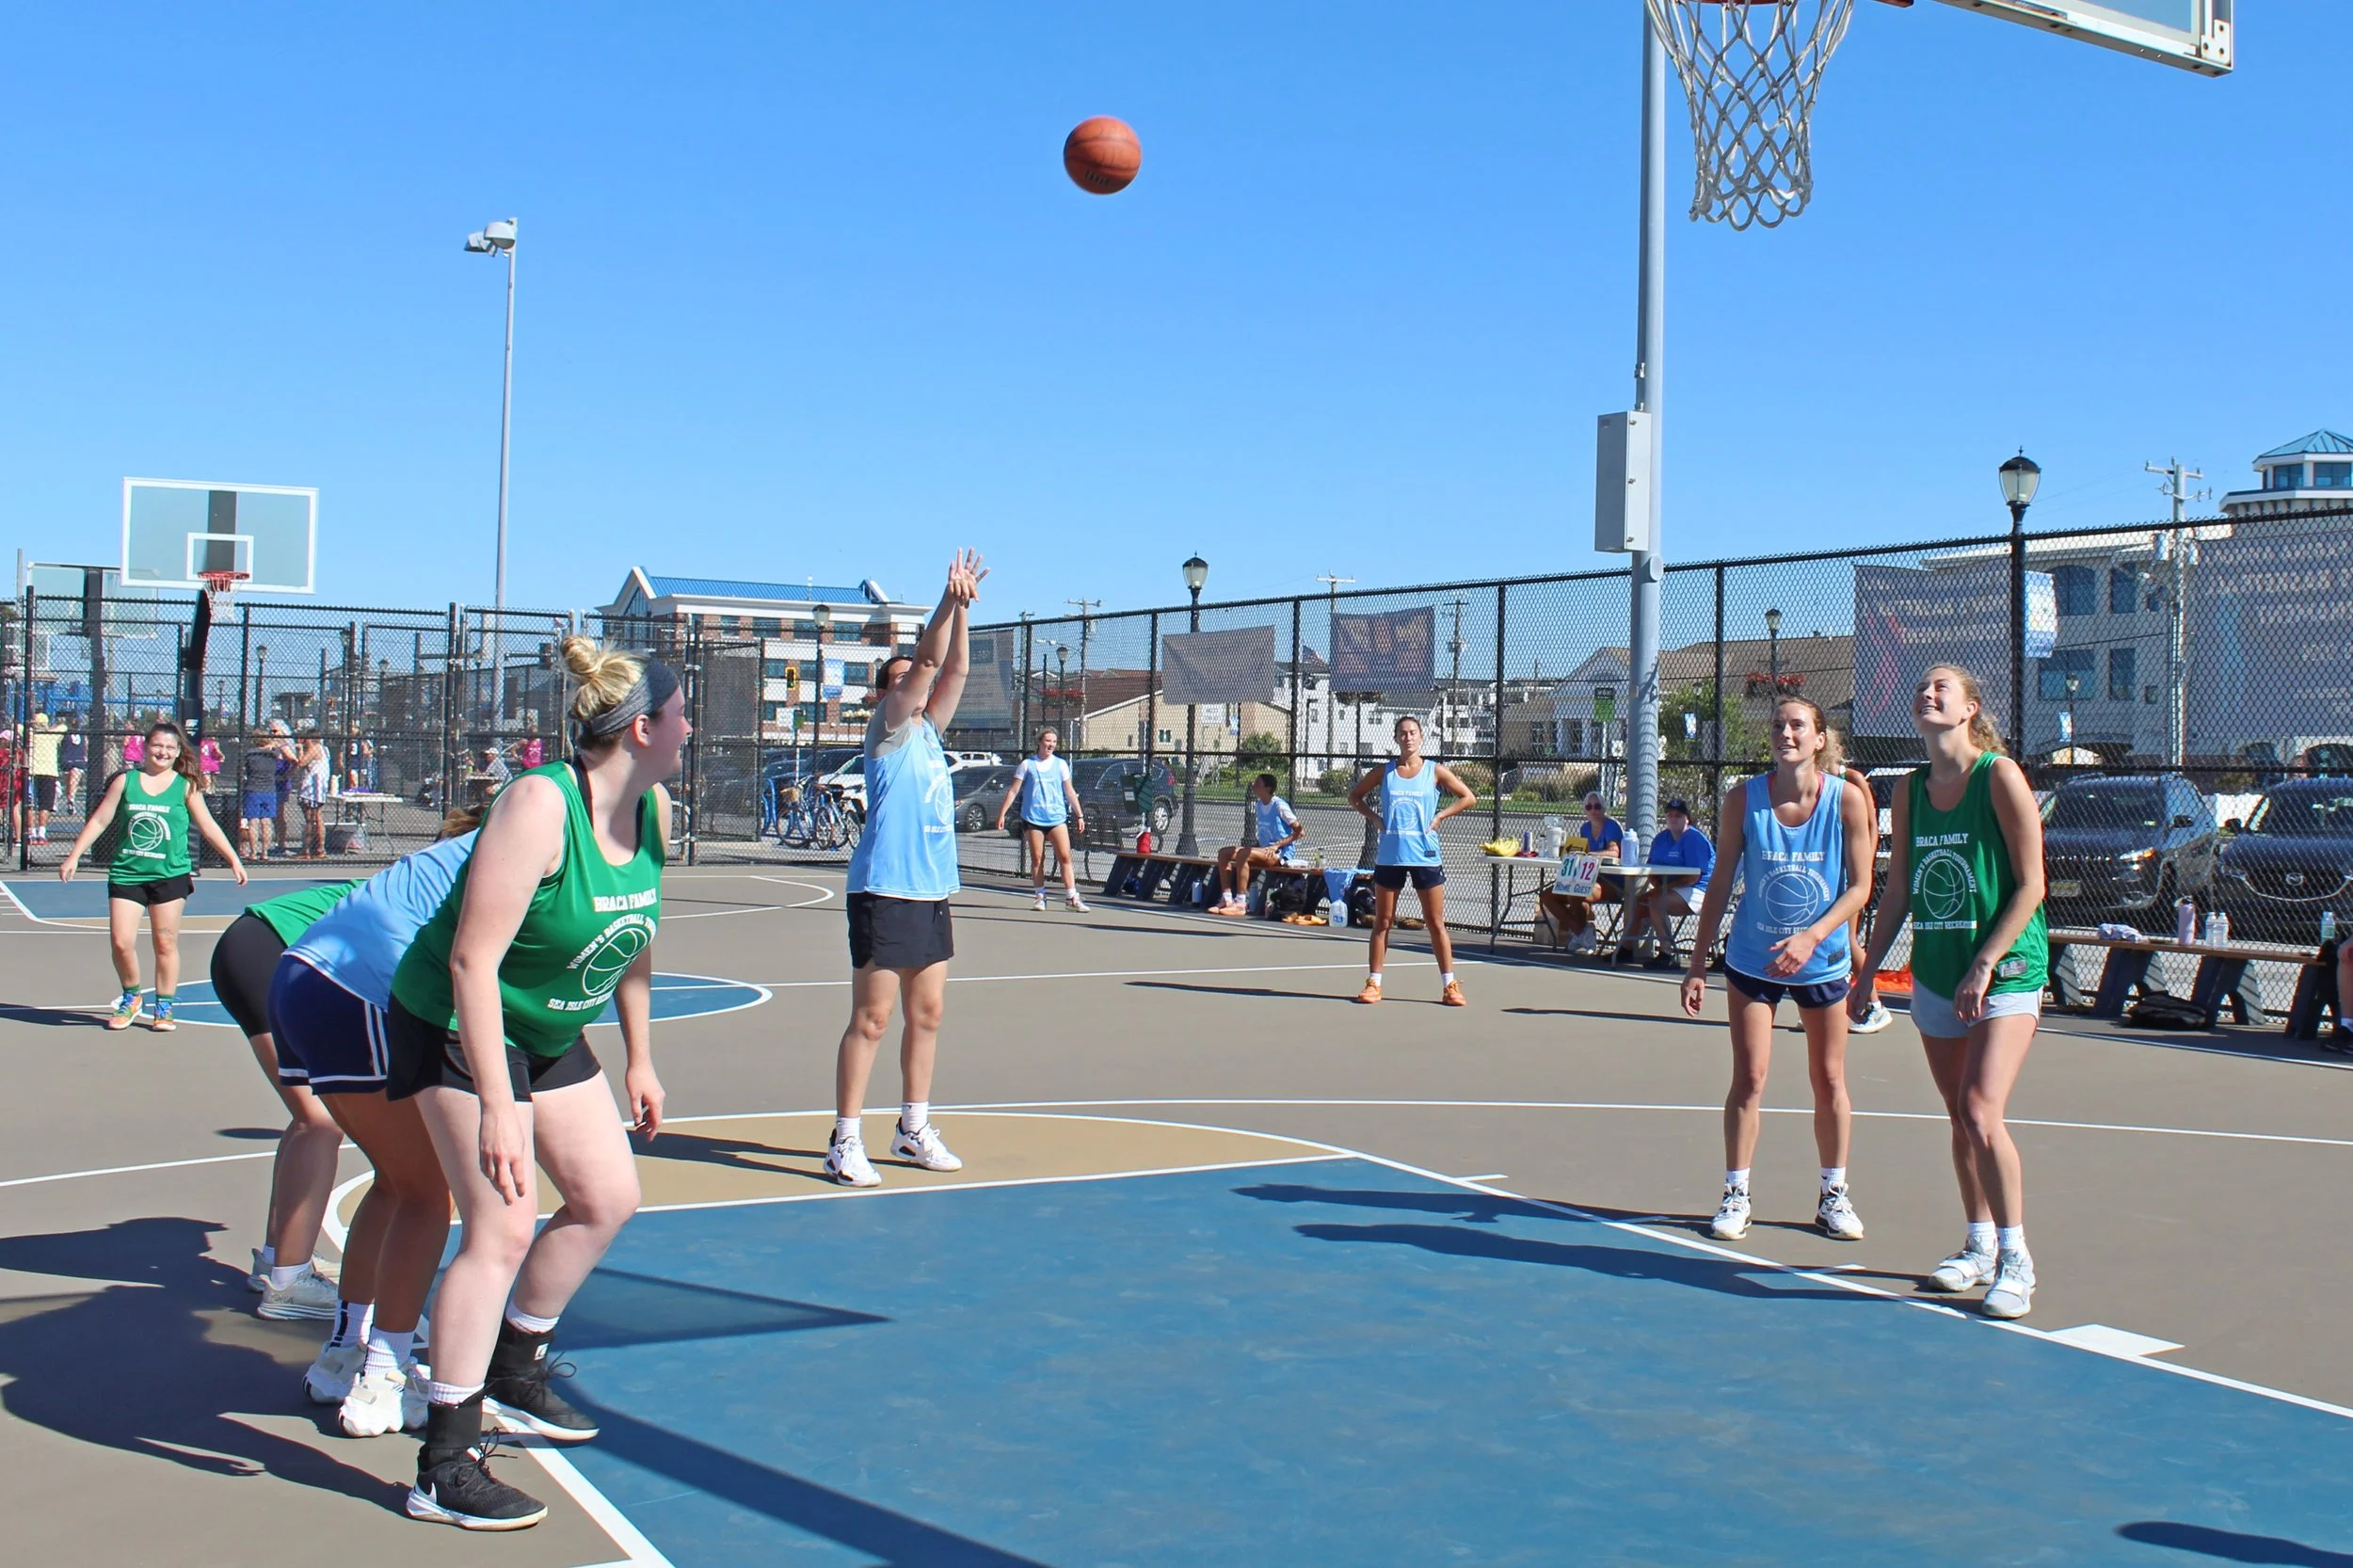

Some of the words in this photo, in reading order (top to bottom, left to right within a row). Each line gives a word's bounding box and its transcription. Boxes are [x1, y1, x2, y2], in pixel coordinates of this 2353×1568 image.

[1915, 836, 1939, 847] BRACA
[1940, 833, 1969, 846] FAMILY
[1792, 851, 1826, 862] FAMILY
[1561, 858, 1575, 876] 31
[1580, 862, 1595, 881] 12
[593, 896, 628, 912] BRACA
[628, 888, 657, 909] FAMILY
[567, 934, 605, 969] WOMEN'S
[603, 913, 645, 938] BASKETBALL
[548, 999, 565, 1010] SEA
